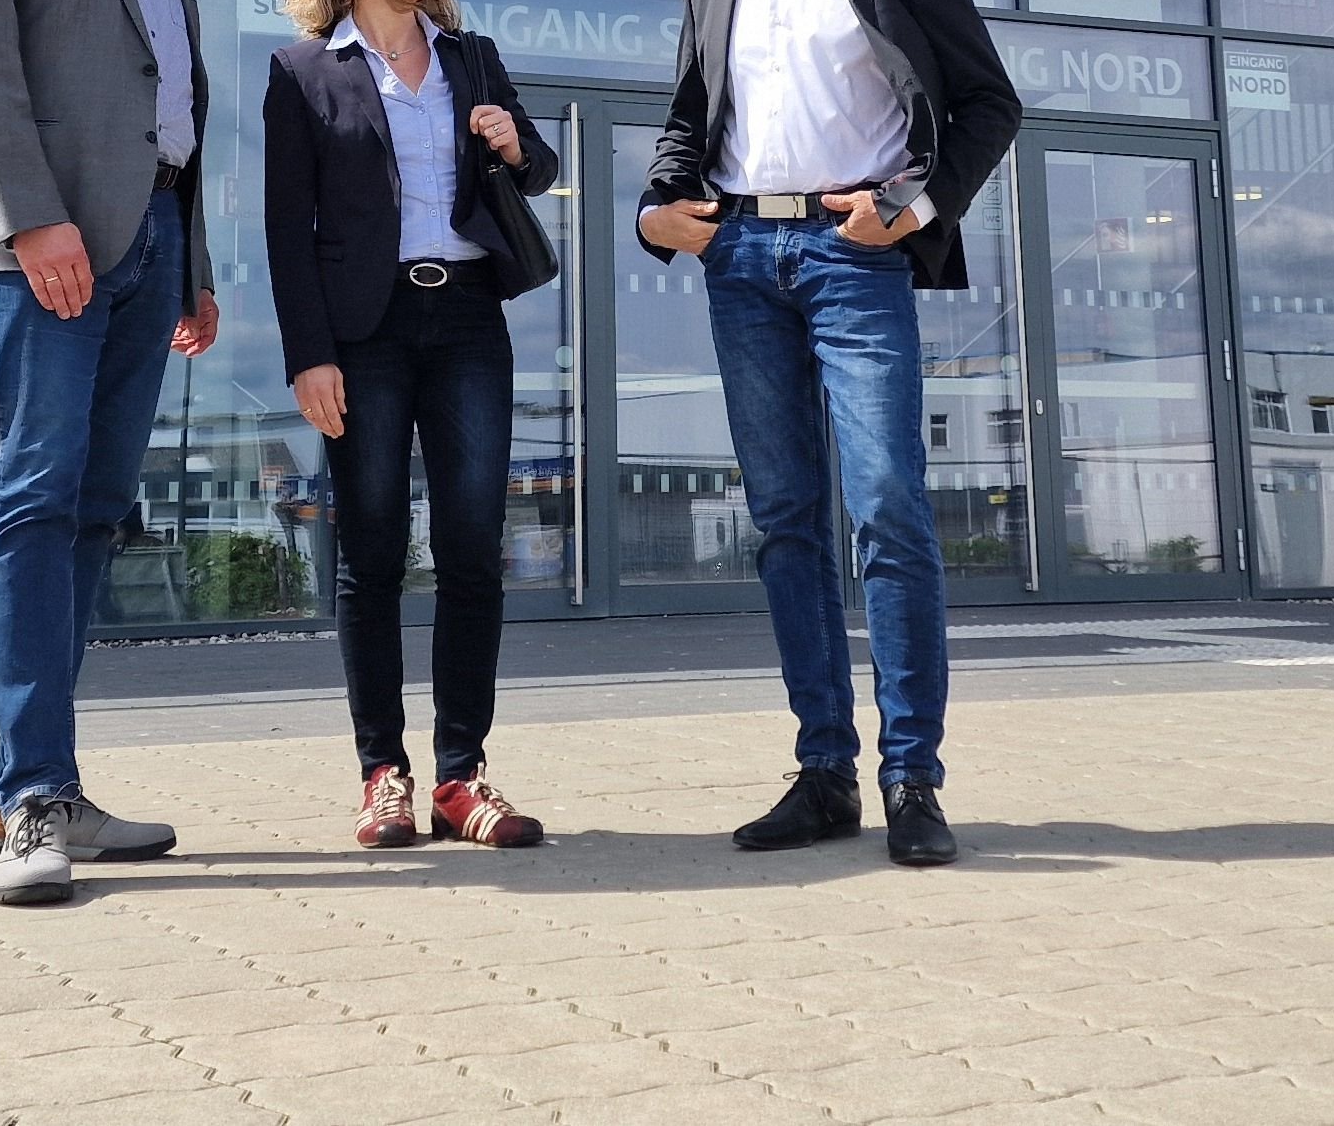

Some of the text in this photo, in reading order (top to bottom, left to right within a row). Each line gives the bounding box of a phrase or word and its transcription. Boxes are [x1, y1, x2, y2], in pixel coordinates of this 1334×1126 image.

[460, 1, 644, 57] NGANG
[1062, 47, 1184, 96] NORD
[1229, 55, 1284, 70] EINGANG
[1229, 75, 1287, 95] NORD
